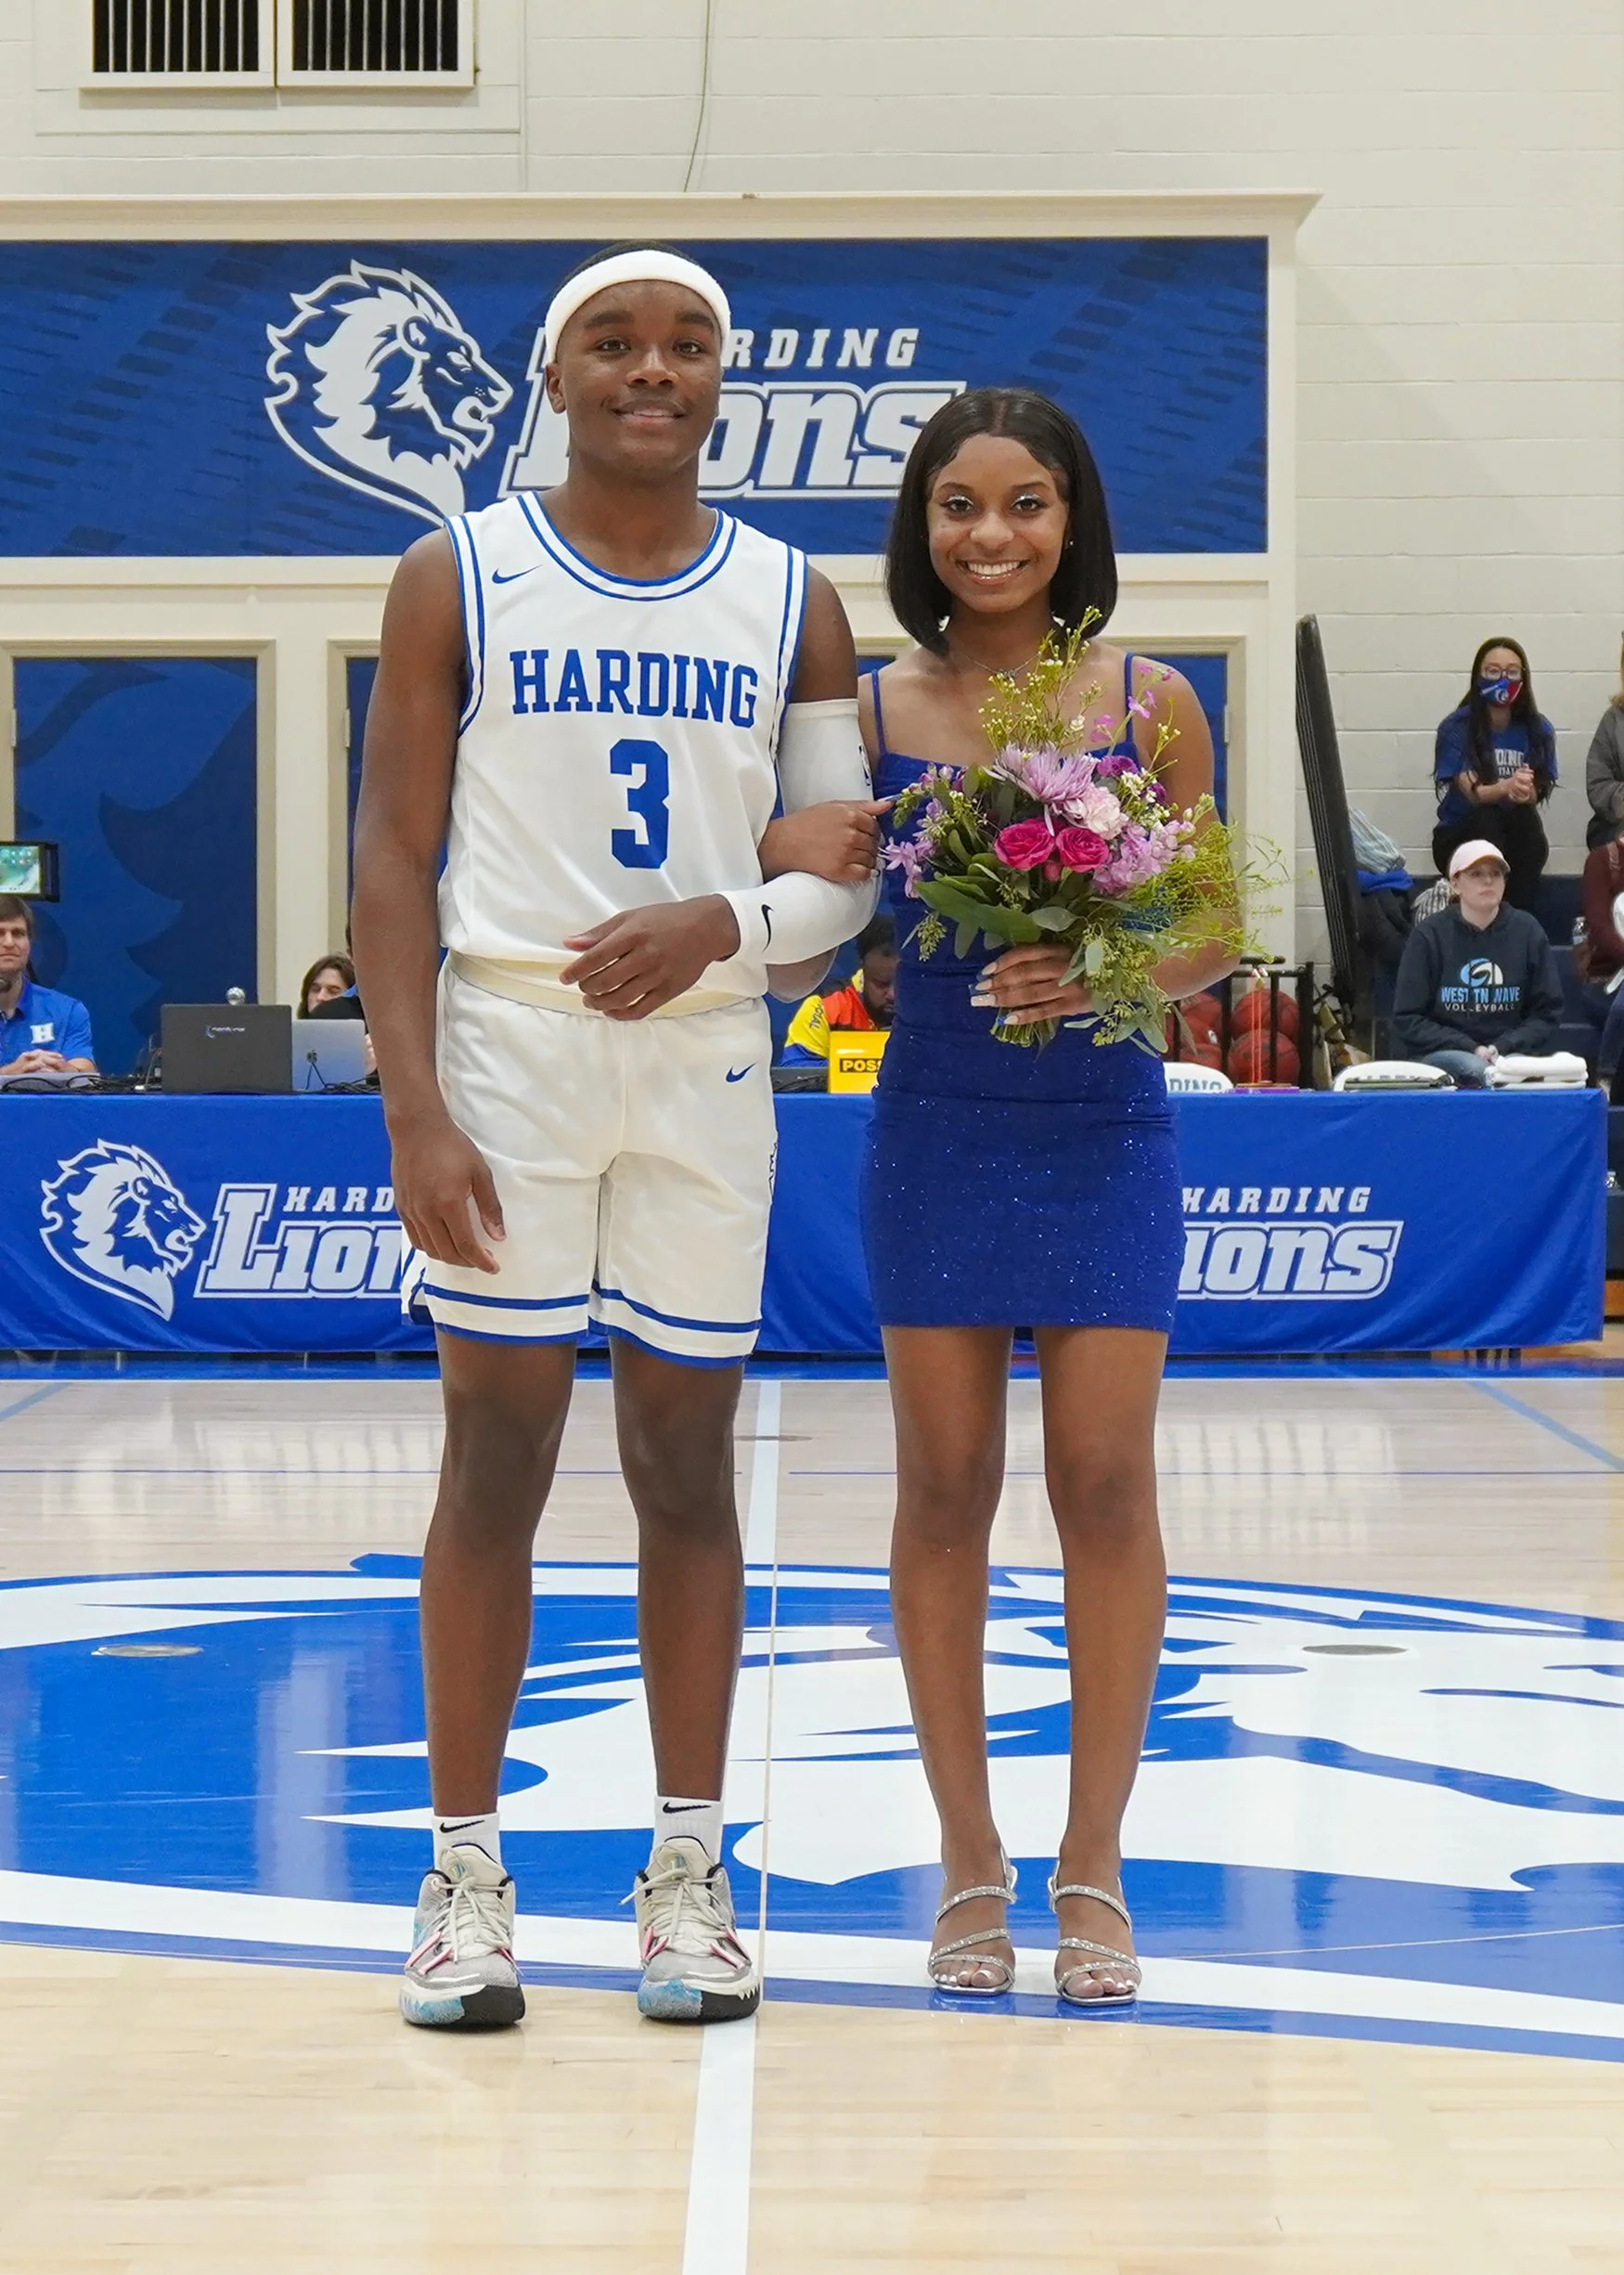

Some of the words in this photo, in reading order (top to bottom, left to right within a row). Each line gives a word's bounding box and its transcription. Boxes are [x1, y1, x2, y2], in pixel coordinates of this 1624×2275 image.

[721, 328, 920, 368] RDING
[509, 648, 758, 729] HARDING
[609, 738, 670, 869] 3
[30, 1022, 56, 1044] H
[282, 1186, 396, 1212] HARD
[1181, 1186, 1372, 1213] HARDING
